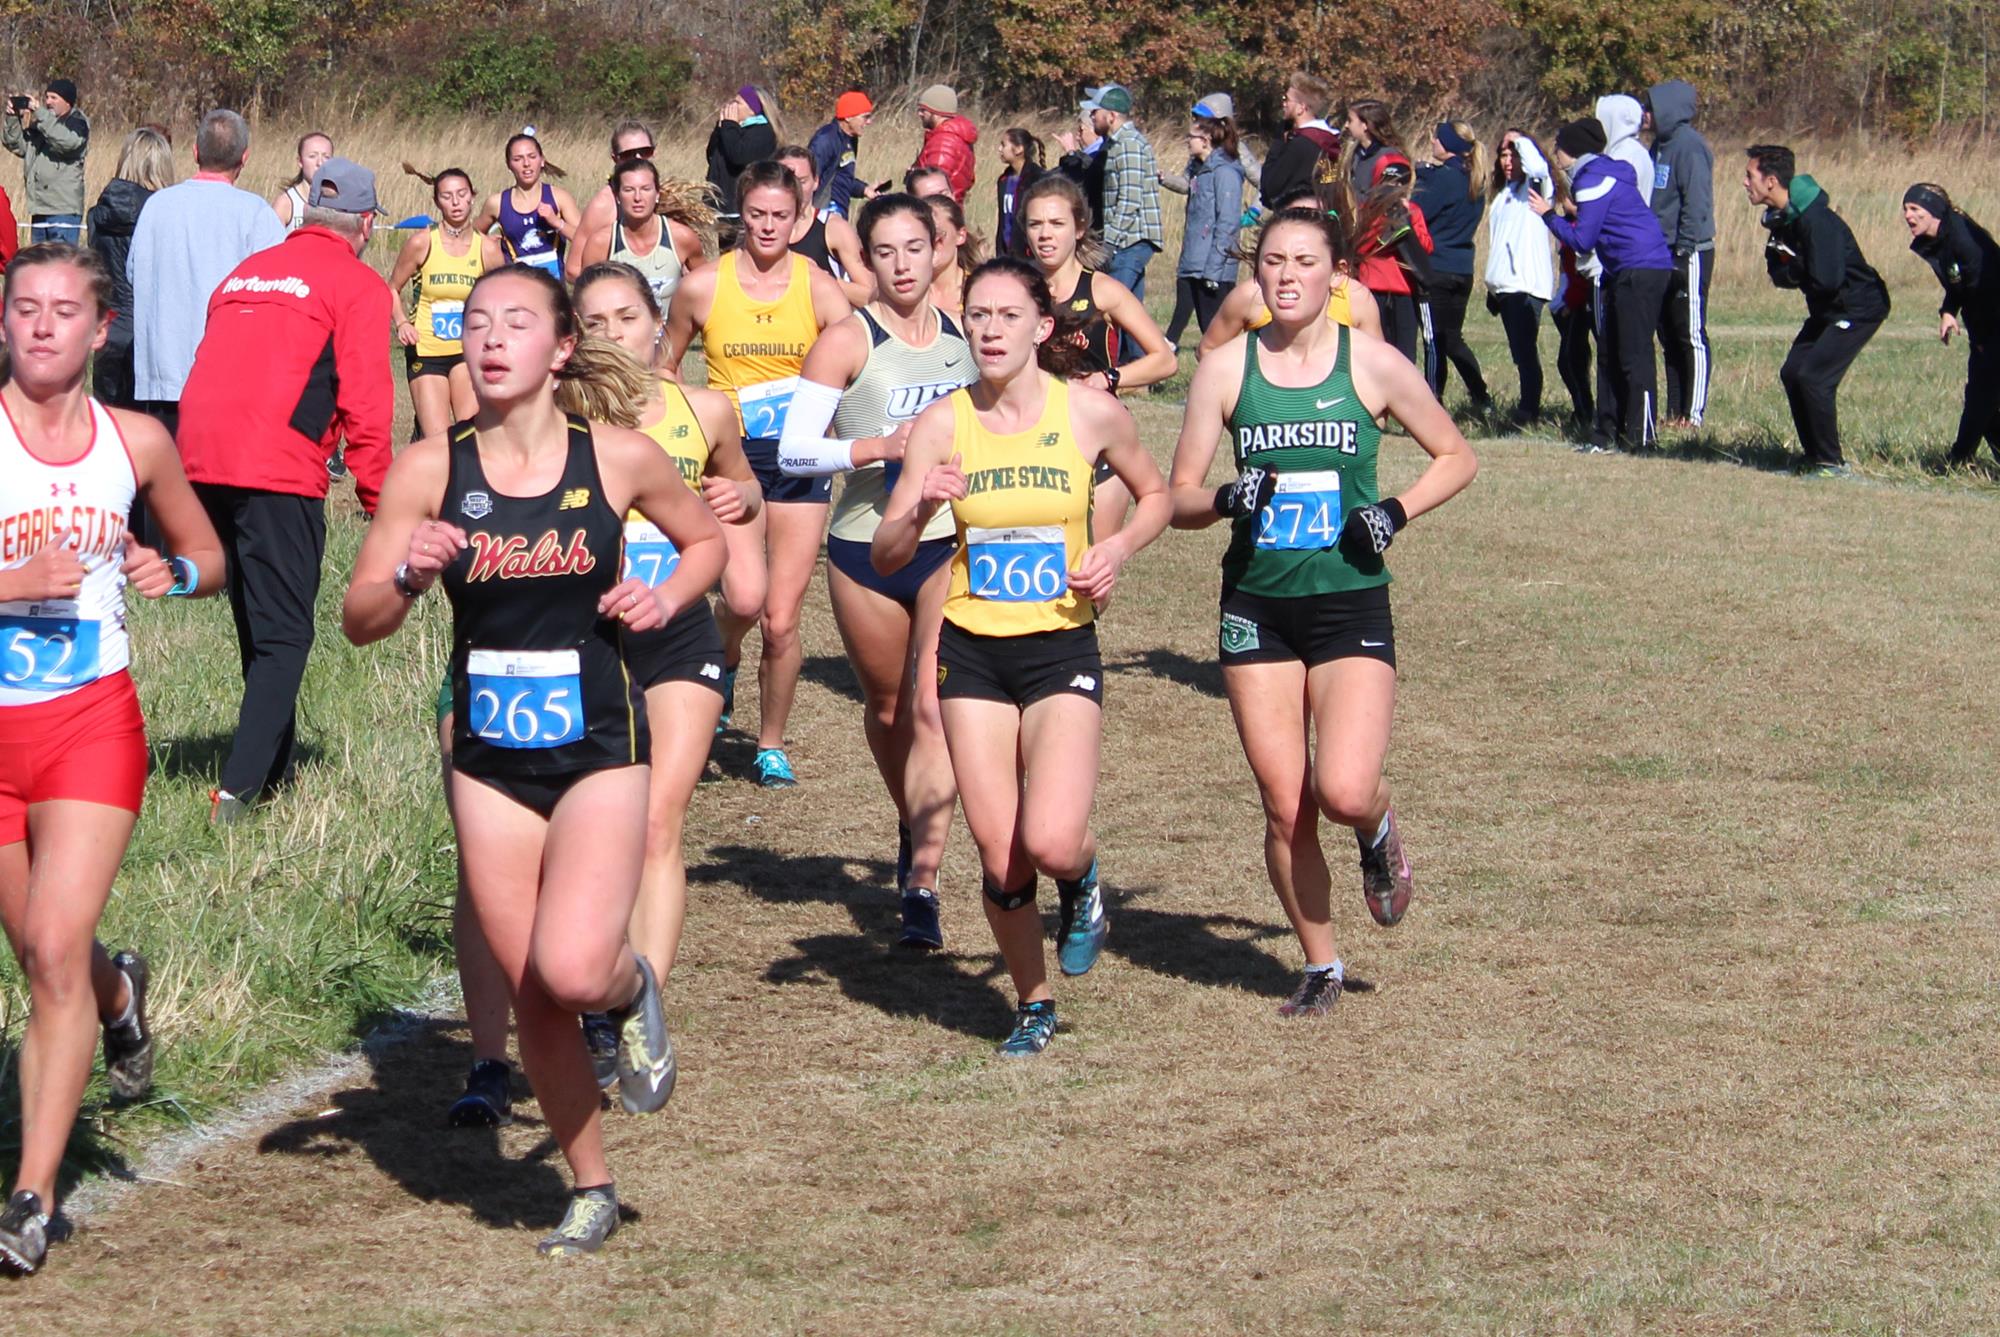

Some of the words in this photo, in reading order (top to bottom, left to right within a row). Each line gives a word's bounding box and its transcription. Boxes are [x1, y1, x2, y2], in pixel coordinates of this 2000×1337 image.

[222, 275, 310, 298] Hortonville
[429, 273, 458, 286] WAYNE
[459, 274, 477, 287] STA
[723, 343, 806, 358] CEDARVILLE
[1239, 421, 1357, 459] PARKSIDE
[671, 456, 699, 483] ATE
[780, 457, 819, 467] PRAIRIE
[1018, 466, 1071, 494] STATE
[0, 506, 63, 562] ERRIS
[1257, 502, 1335, 545] 274
[466, 528, 597, 584] Walsh
[975, 554, 1061, 597] 266
[5, 632, 74, 684] 52
[476, 689, 572, 742] 265
